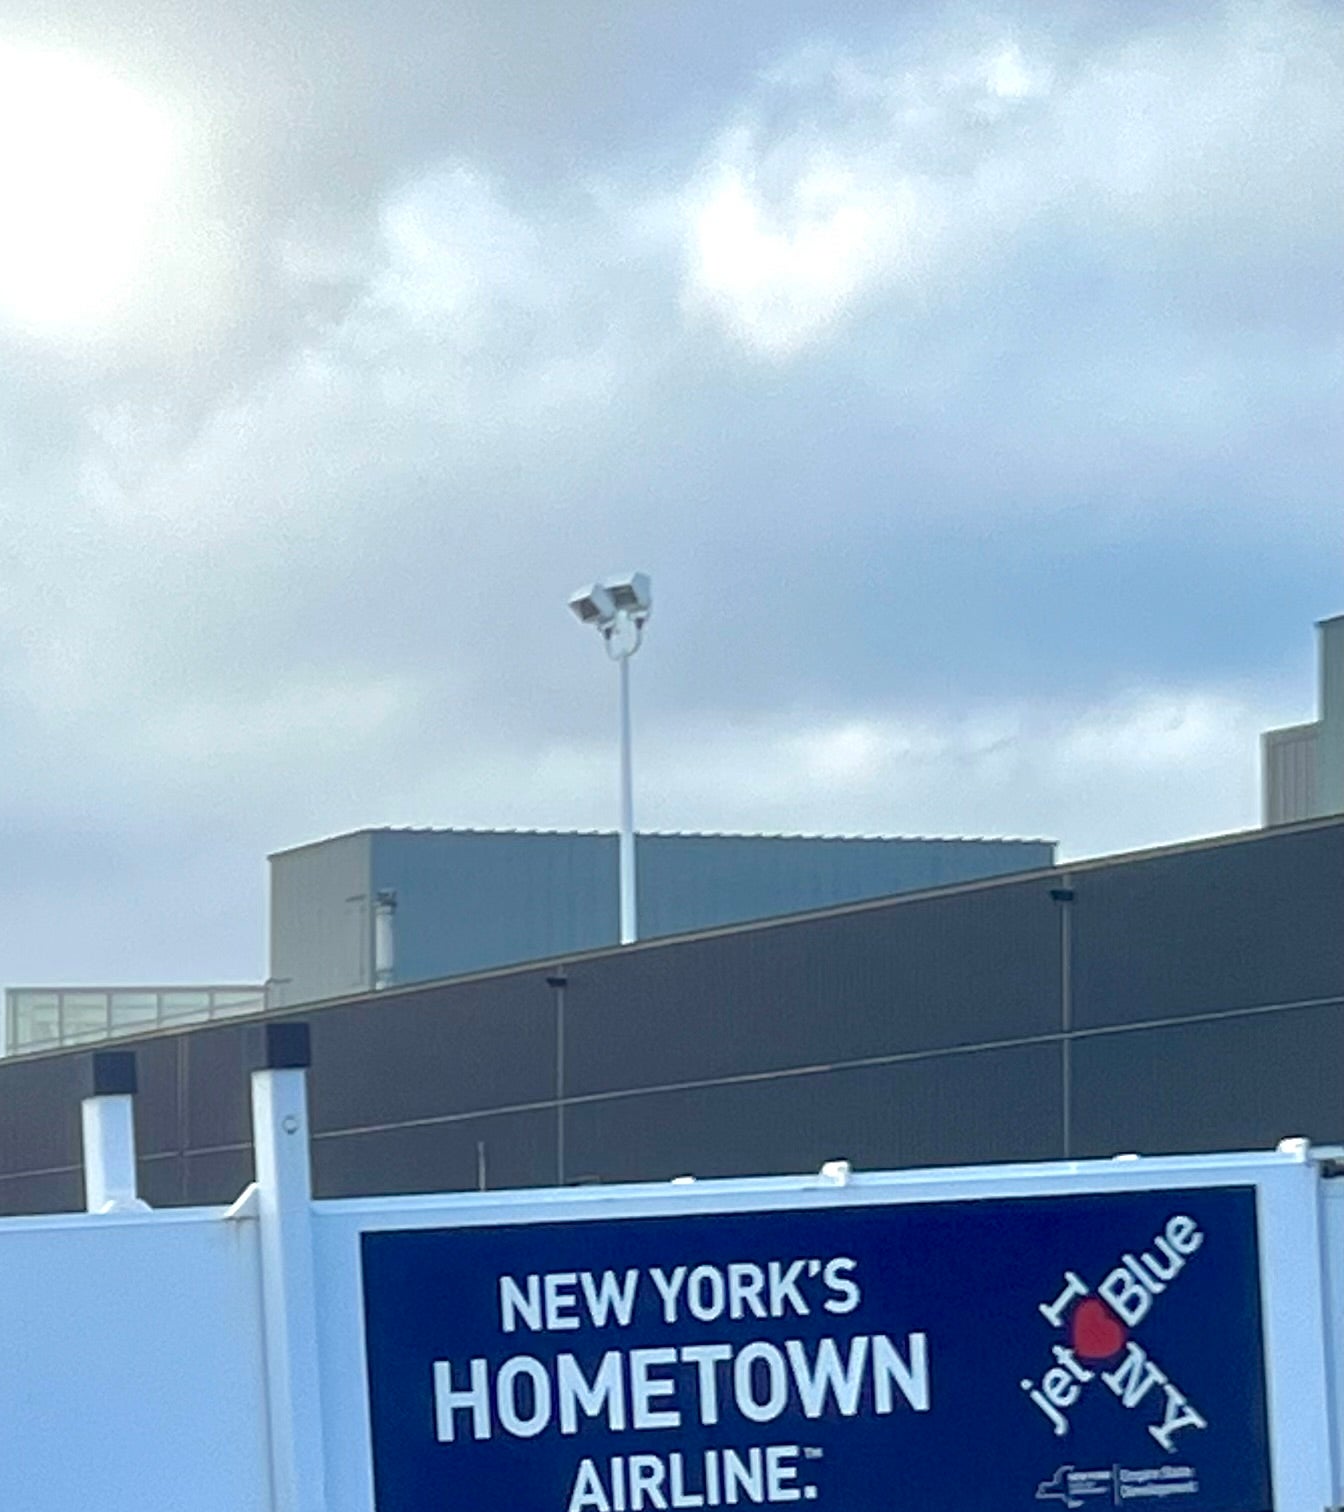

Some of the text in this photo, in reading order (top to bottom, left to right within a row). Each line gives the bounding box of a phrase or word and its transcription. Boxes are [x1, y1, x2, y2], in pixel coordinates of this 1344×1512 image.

[499, 1257, 861, 1332] NEW YORK'S
[1098, 1215, 1204, 1327] Blue
[432, 1332, 931, 1442] HOMETOWN
[1020, 1345, 1095, 1436] jet
[1101, 1341, 1208, 1453] NY
